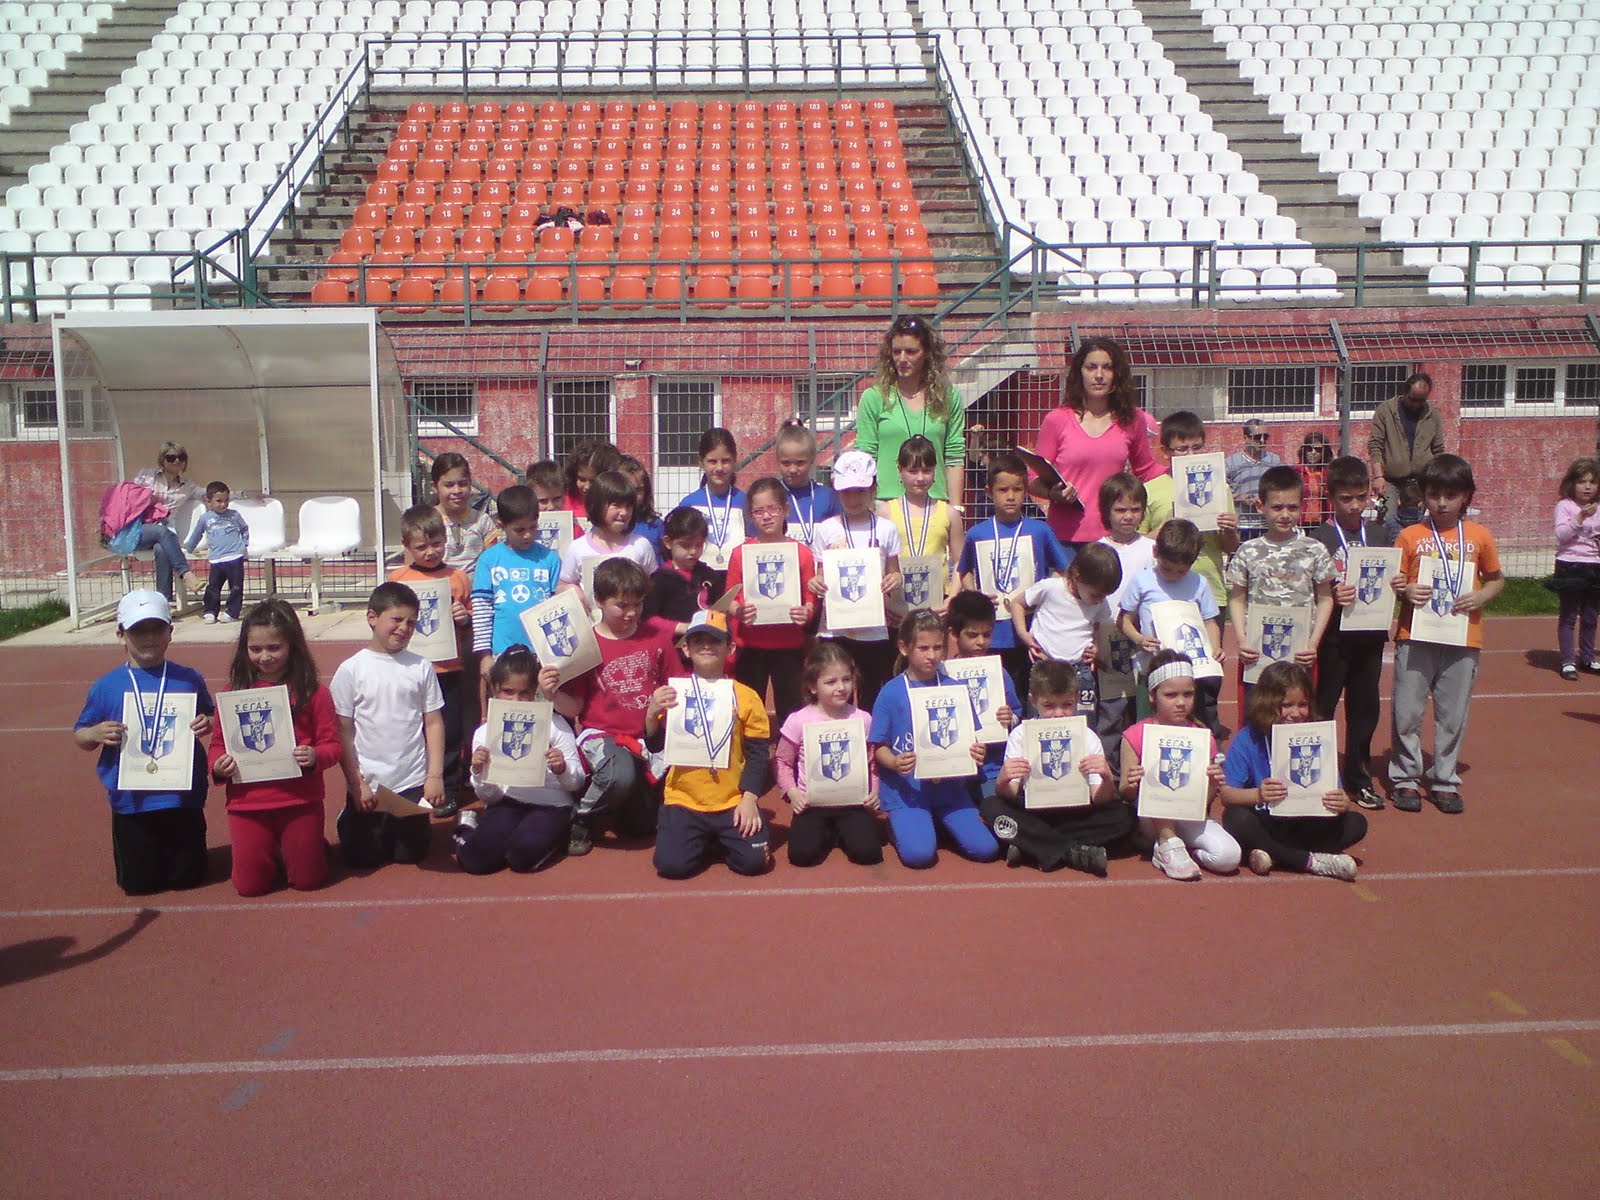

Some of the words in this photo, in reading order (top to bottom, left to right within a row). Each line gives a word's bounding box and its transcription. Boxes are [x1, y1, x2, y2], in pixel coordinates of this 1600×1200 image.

[636, 184, 646, 192] 38
[673, 184, 683, 192] 39
[709, 184, 719, 193] 40
[746, 184, 755, 192] 41
[782, 183, 793, 191] 42
[818, 183, 829, 191] 43
[854, 182, 865, 190] 44
[891, 181, 901, 189] 45
[377, 187, 387, 195] 31
[415, 186, 425, 195] 32
[452, 186, 462, 195] 33
[489, 186, 499, 194] 34
[526, 186, 537, 195] 35
[562, 186, 573, 195] 36
[671, 208, 681, 216] 24
[748, 207, 758, 215] 26
[785, 206, 795, 215] 27
[822, 204, 833, 213] 28
[861, 204, 871, 213] 29
[898, 204, 909, 212] 30
[405, 210, 415, 218] 17
[442, 209, 452, 218] 18
[482, 210, 492, 218] 19
[519, 209, 530, 217] 20
[634, 208, 644, 217] 23
[710, 230, 720, 239] 10
[749, 229, 758, 238] 11
[788, 229, 798, 237] 12
[827, 228, 837, 237] 13
[866, 229, 876, 237] 14
[905, 227, 915, 236] 15
